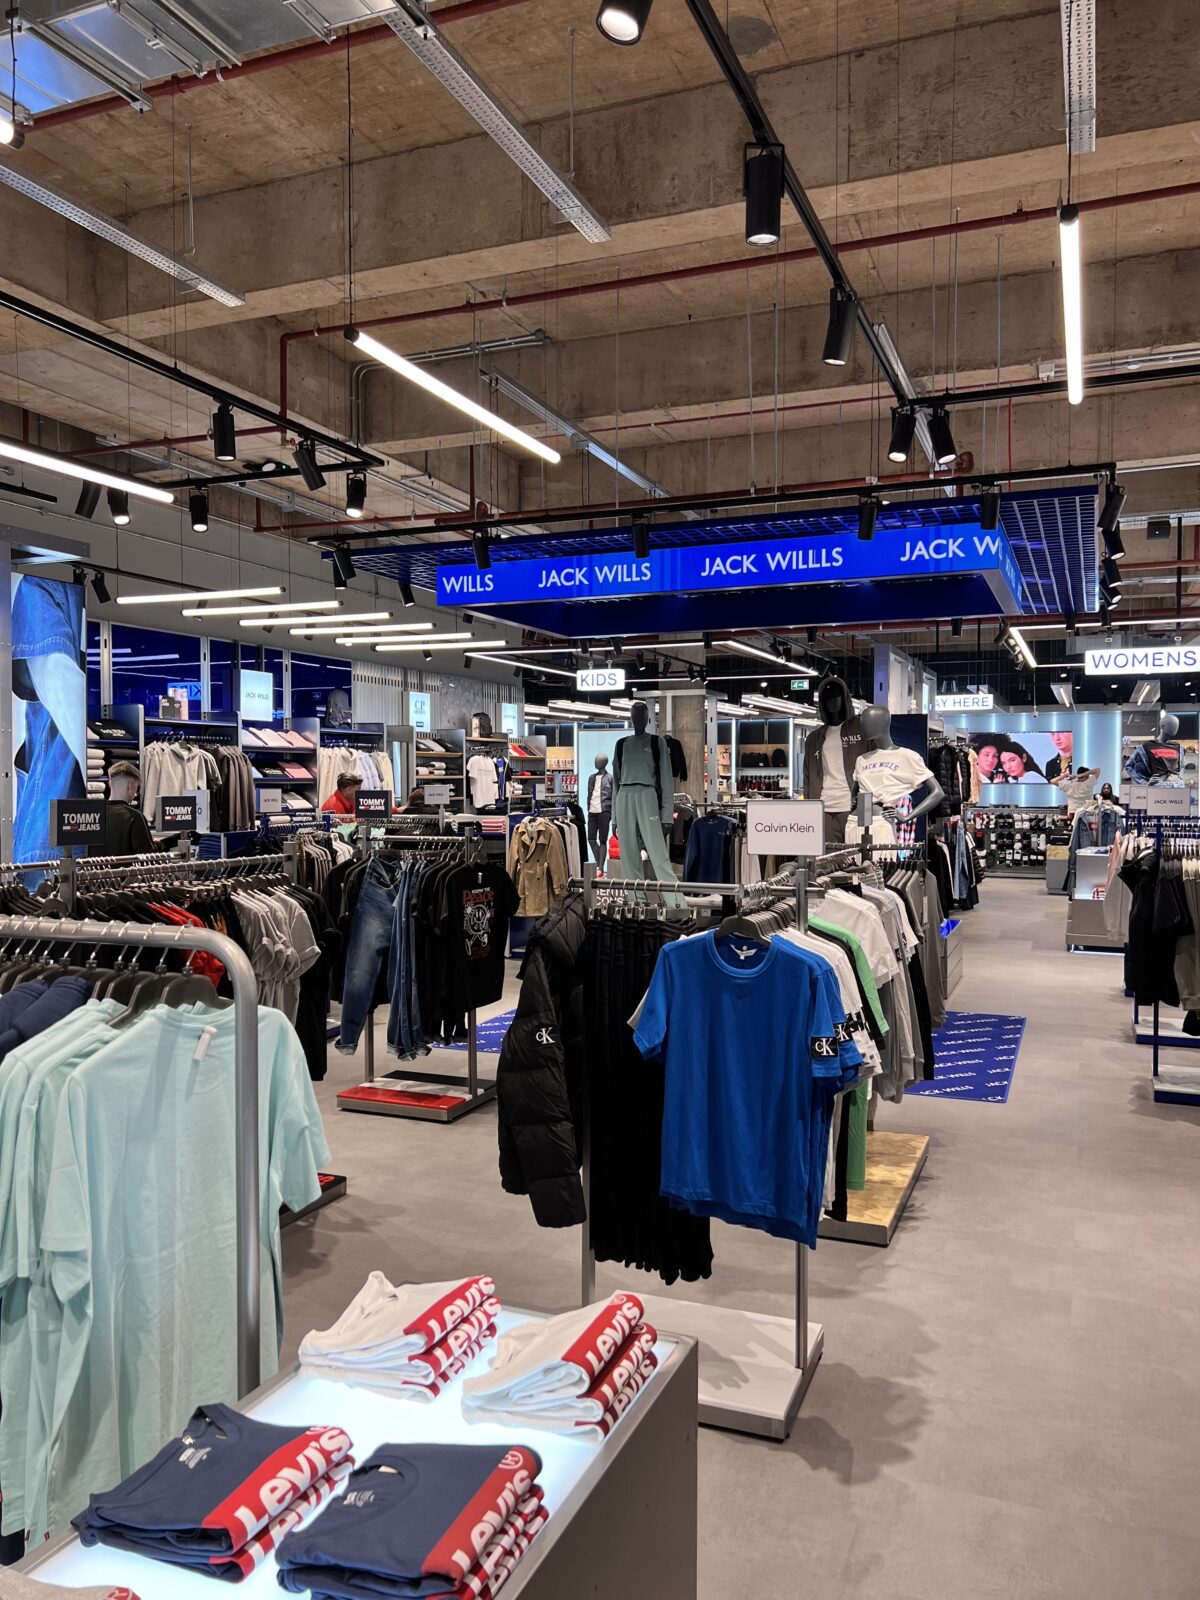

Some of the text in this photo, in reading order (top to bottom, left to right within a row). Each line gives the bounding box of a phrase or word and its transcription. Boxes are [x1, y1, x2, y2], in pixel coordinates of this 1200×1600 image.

[900, 537, 965, 562] JACK
[701, 554, 758, 577] JACK
[538, 562, 652, 588] JACK WILLS
[442, 574, 494, 593] WILLS
[1092, 650, 1198, 668] WOMENS
[580, 672, 617, 687] KIDS
[953, 697, 990, 708] HERE
[358, 798, 386, 806] TOMMY
[164, 806, 193, 815] TOMMY
[62, 813, 101, 824] TOMMY
[78, 823, 101, 832] JEANS
[754, 821, 815, 833] Calvin Klein
[233, 1428, 352, 1541] Levi's
